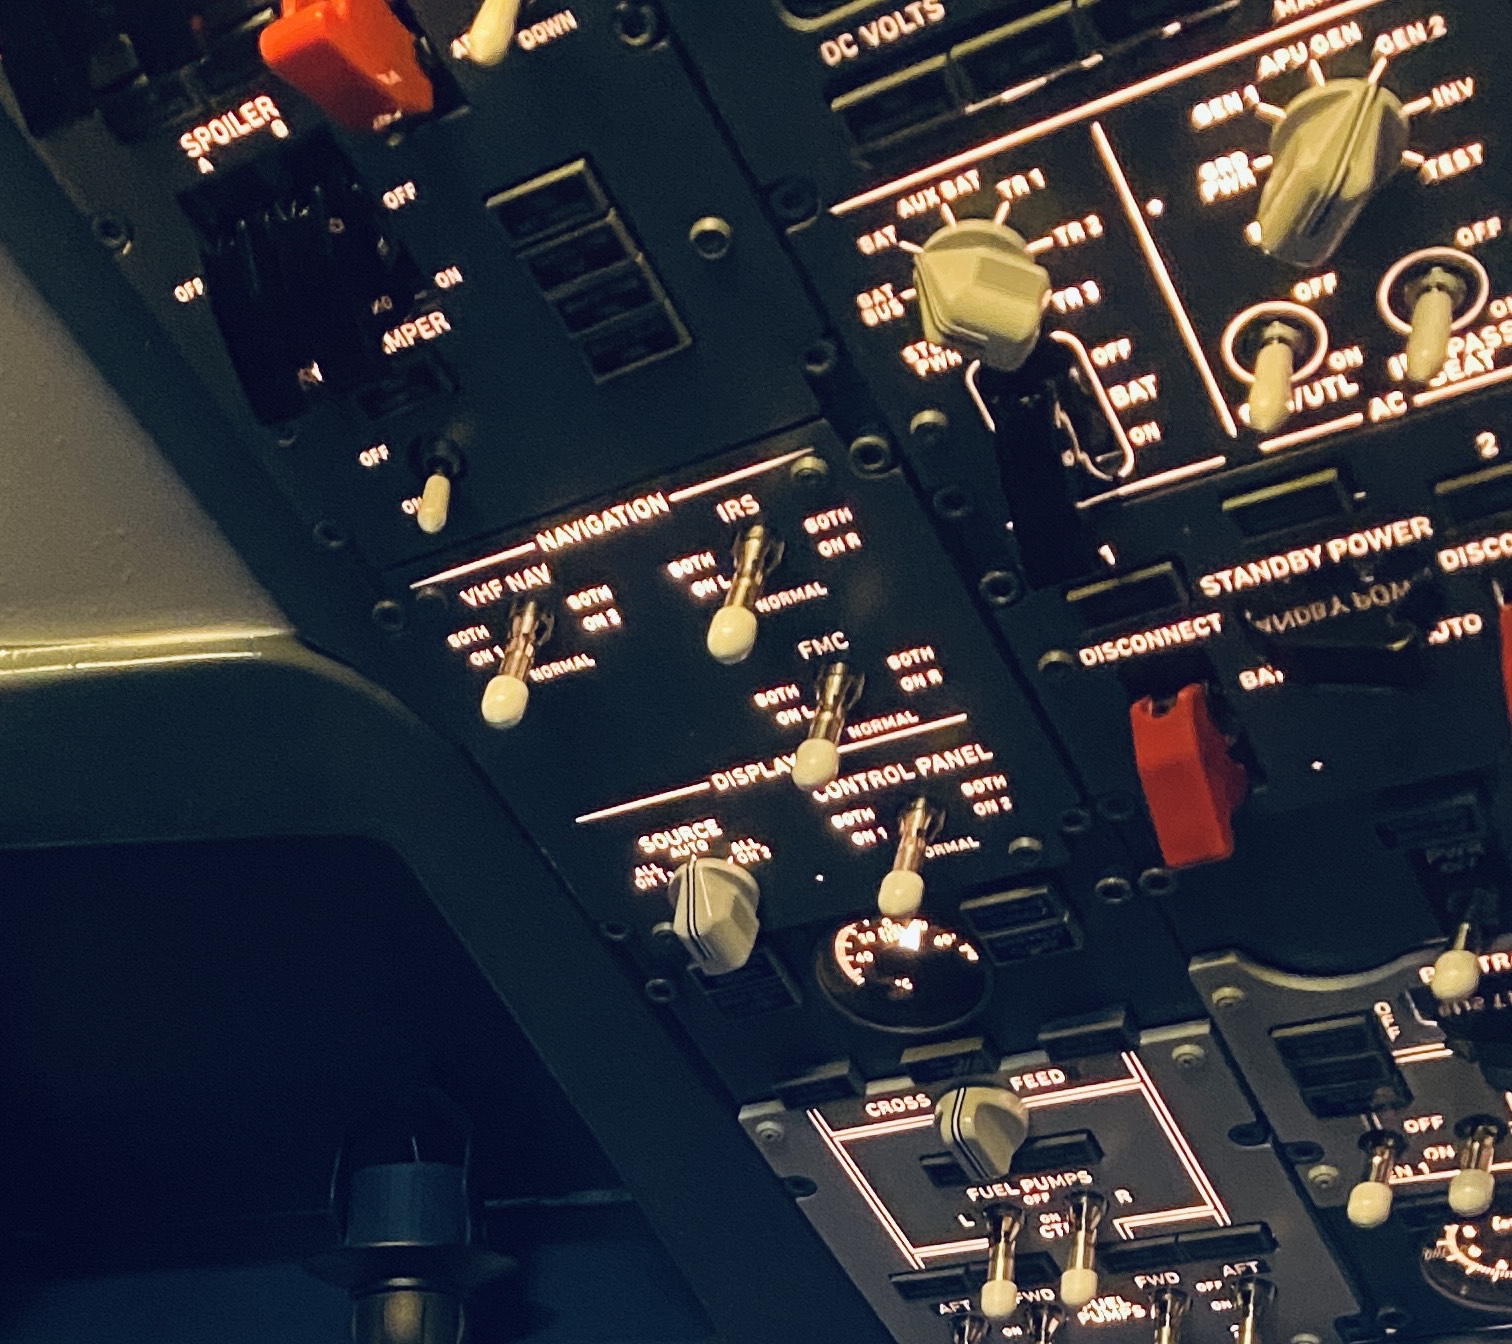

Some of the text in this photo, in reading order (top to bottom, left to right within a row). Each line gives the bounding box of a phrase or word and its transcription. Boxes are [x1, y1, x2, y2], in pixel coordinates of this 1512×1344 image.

[820, 0, 945, 66] DC VOLTS
[1431, 77, 1474, 111] INV
[179, 95, 280, 158] SPOILER
[1422, 143, 1483, 184] TEST
[383, 181, 416, 210] OFF
[897, 186, 940, 219] AUX
[857, 224, 896, 255] BAT
[1455, 216, 1501, 249] OFF
[175, 277, 204, 302] OFF
[435, 265, 463, 289] ON
[1292, 271, 1336, 303] OFF
[1091, 337, 1131, 367] OFF
[1328, 346, 1363, 372] ON
[1108, 374, 1157, 410] BAT
[1368, 390, 1407, 422] AC
[1129, 421, 1161, 447] ON
[1475, 430, 1499, 459] 2
[359, 443, 389, 467] OFF
[716, 494, 759, 523] IRS
[803, 508, 853, 533] BOTH
[536, 492, 669, 552] NAVIGATION
[668, 552, 715, 578] BOTH
[1200, 516, 1433, 597] STANDBY POWER
[459, 564, 551, 607] VHF NAV
[567, 585, 613, 610] BOTH
[756, 582, 827, 613] NORMAL
[448, 625, 490, 648] BOTH
[797, 631, 850, 659] FMC
[1078, 612, 1223, 668] DISCONNECT
[530, 653, 595, 683] NORMAL
[887, 647, 934, 670] BOTH
[754, 684, 799, 708] BOTH
[847, 709, 918, 738] NORMAL
[710, 754, 797, 794] DISPLAY
[813, 743, 994, 803] CONTROL PANEL
[960, 773, 1007, 796] BOTH
[830, 807, 875, 830] BOTH
[637, 818, 722, 855] SOURCE
[670, 839, 709, 860] AUTO
[731, 837, 760, 856] ALL
[634, 864, 663, 880] ALL
[1010, 1067, 1066, 1092] FEED
[865, 1091, 931, 1116] CROSS
[1402, 1114, 1444, 1133] OFF
[1423, 1144, 1456, 1161] ON
[966, 1170, 1093, 1202] FUEL PUMPS
[1023, 1192, 1050, 1206] OFF
[1114, 1188, 1133, 1204] R
[958, 1214, 976, 1228] L
[1133, 1272, 1181, 1289] FWD
[1223, 1260, 1259, 1278] AFT
[1195, 1280, 1222, 1293] OFF
[938, 1299, 970, 1315] AFT
[1210, 1300, 1233, 1311] ON
[1001, 1325, 1023, 1338] ON
